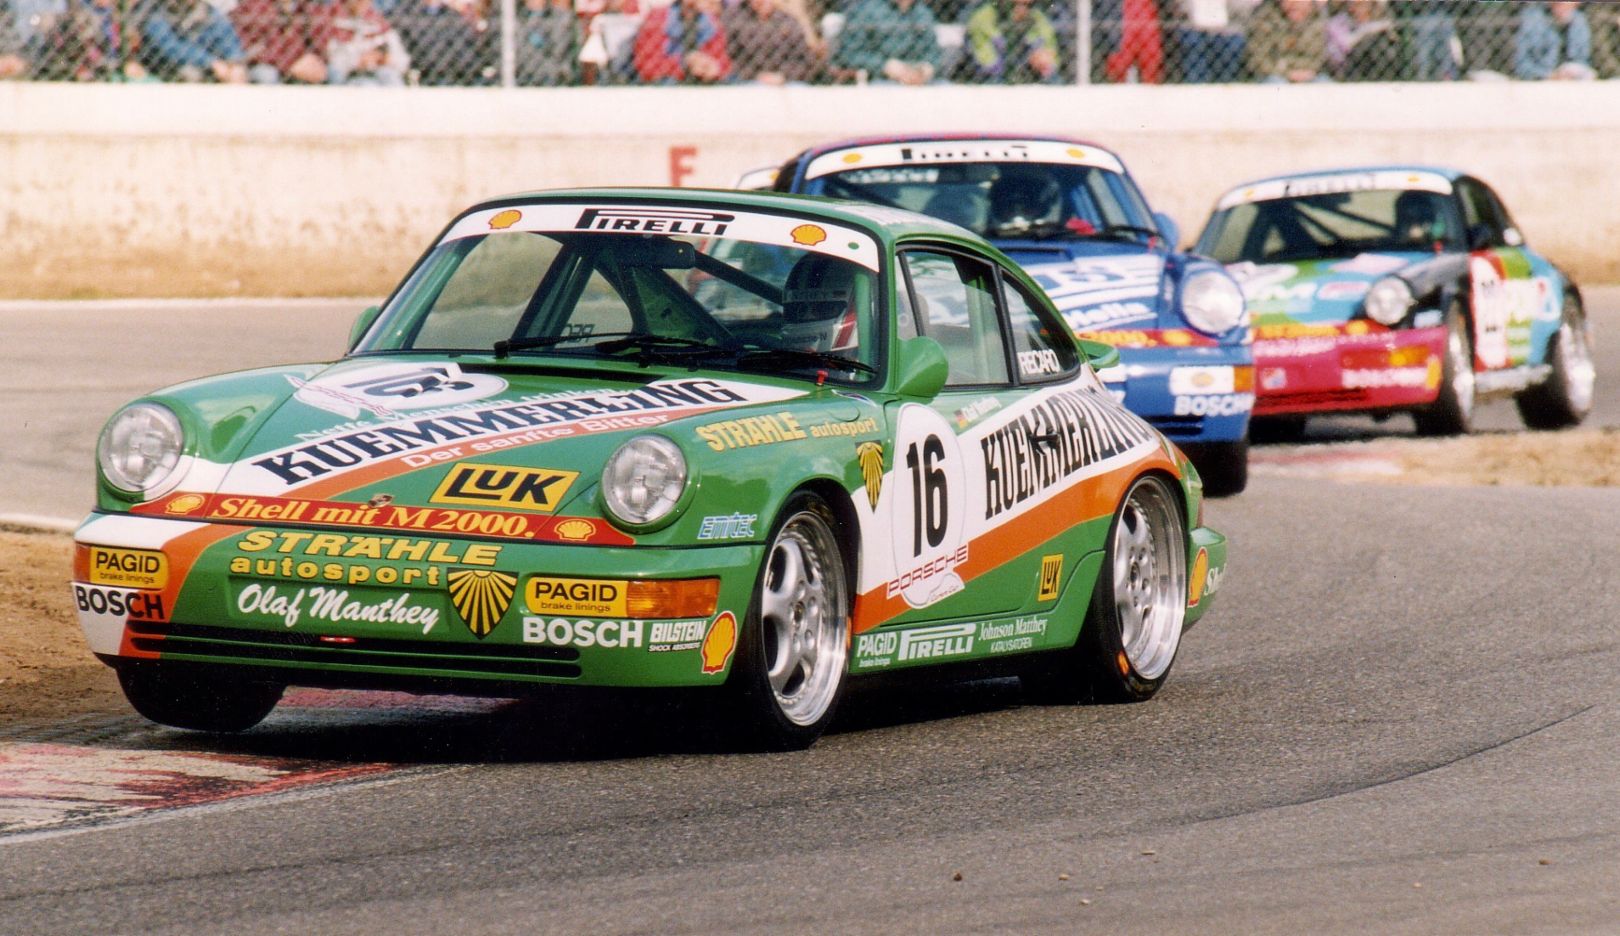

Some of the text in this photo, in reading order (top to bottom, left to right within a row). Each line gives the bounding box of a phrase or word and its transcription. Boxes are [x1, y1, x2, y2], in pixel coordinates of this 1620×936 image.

[574, 208, 735, 237] PIRELLI
[252, 379, 749, 486] KUEMMERLING
[400, 413, 670, 469] Der sanfte Bitter
[809, 418, 880, 440] autosport
[906, 433, 949, 558] 16
[211, 496, 304, 522] Shell
[310, 504, 383, 526] mit
[96, 551, 161, 574] PAGID
[237, 530, 504, 567] STRÄHLE
[99, 573, 155, 585] brake linings
[230, 556, 441, 586] autosport
[887, 545, 968, 599] PORSCHE
[74, 585, 166, 621] BOSCH
[535, 581, 618, 603] PAGID
[540, 600, 612, 614] brake linings
[237, 584, 441, 636] Olaf Manthey
[522, 617, 644, 649] BOSCH
[649, 620, 707, 643] BILSTEIN
[897, 622, 977, 661] PIRELLI
[978, 616, 1049, 641] Johnson Matthey
[857, 632, 898, 658] PAGID
